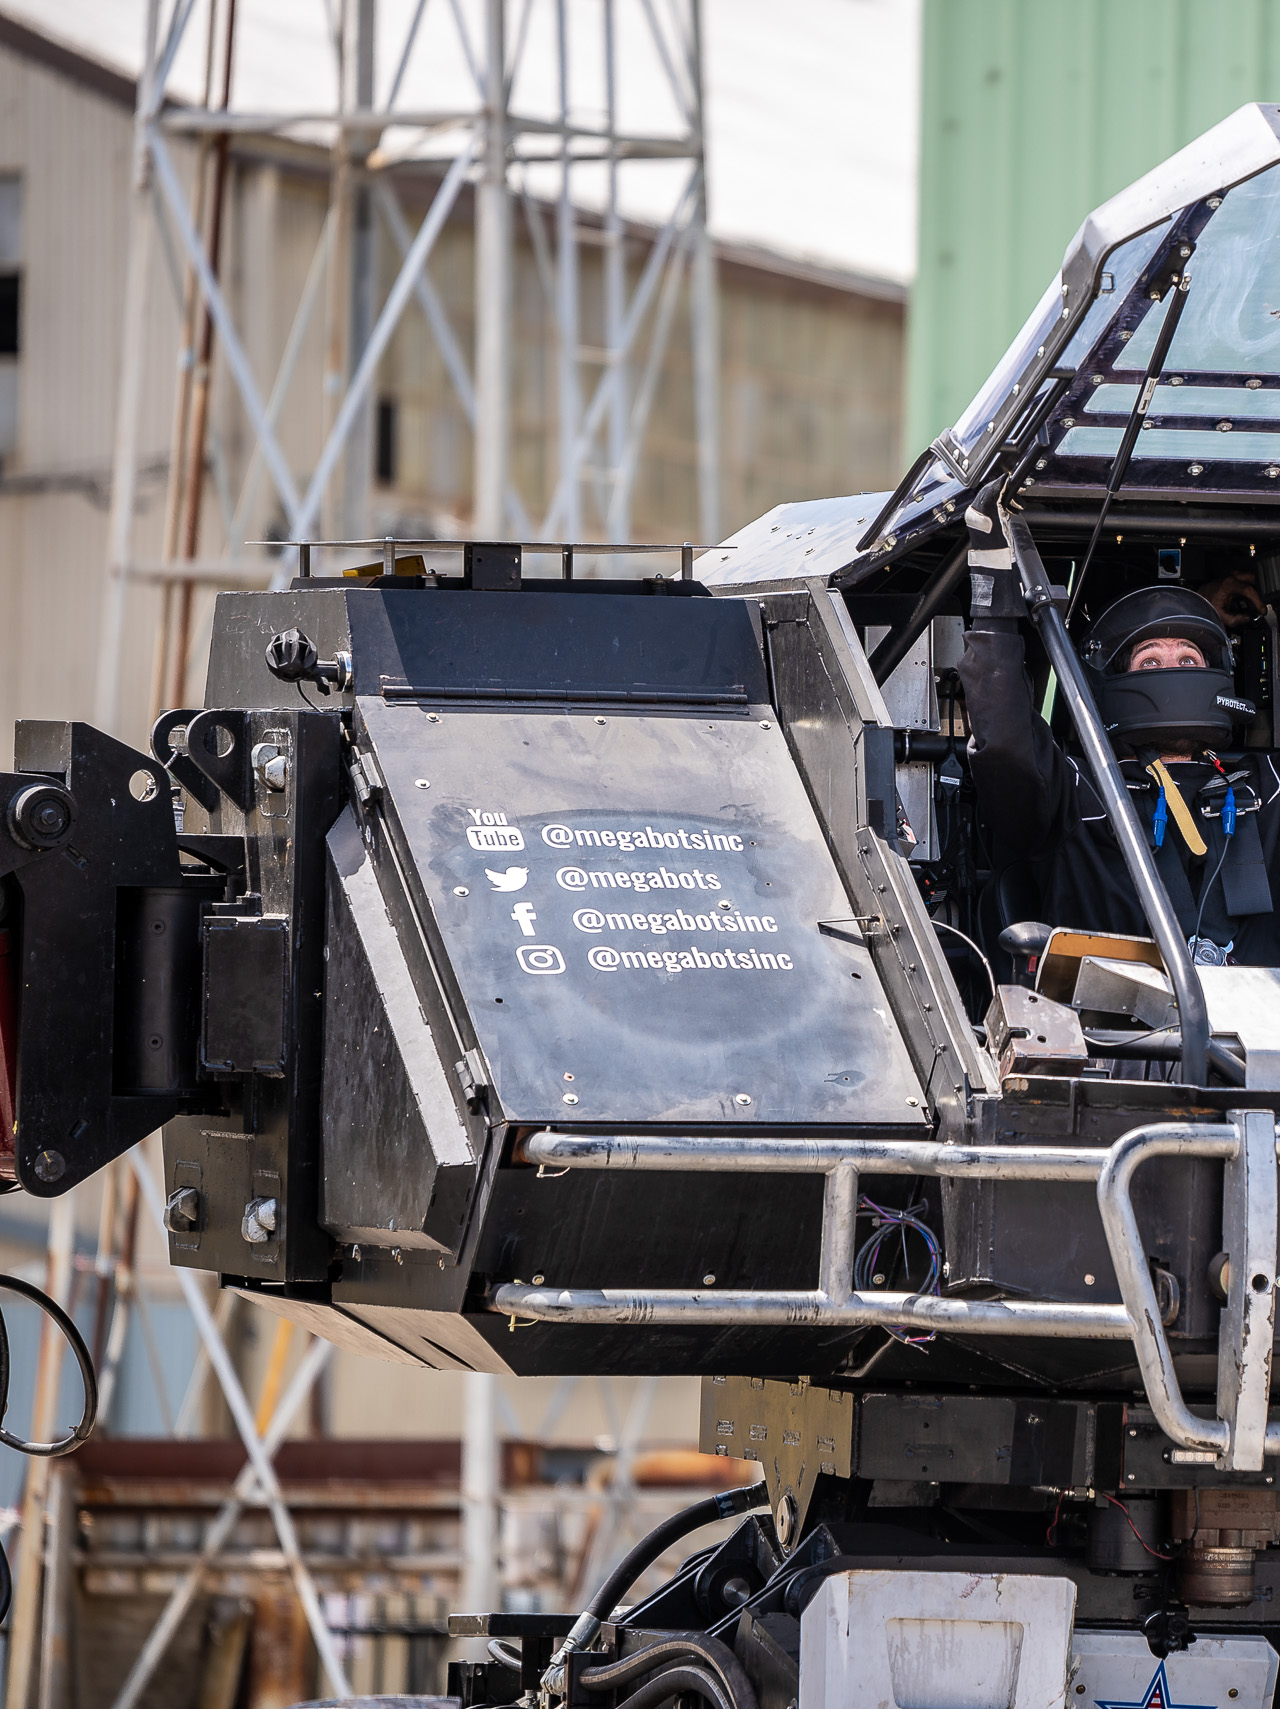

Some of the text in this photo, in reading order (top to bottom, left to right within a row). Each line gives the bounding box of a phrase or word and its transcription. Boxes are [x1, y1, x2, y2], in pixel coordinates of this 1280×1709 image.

[1216, 695, 1246, 711] PYROTECT
[467, 808, 507, 826] You
[471, 830, 520, 848] Tube
[541, 824, 744, 851] @megabotsinc
[556, 866, 722, 892] @megabots
[572, 908, 779, 934] @megabotsinc
[587, 946, 794, 973] @megabotsinc
